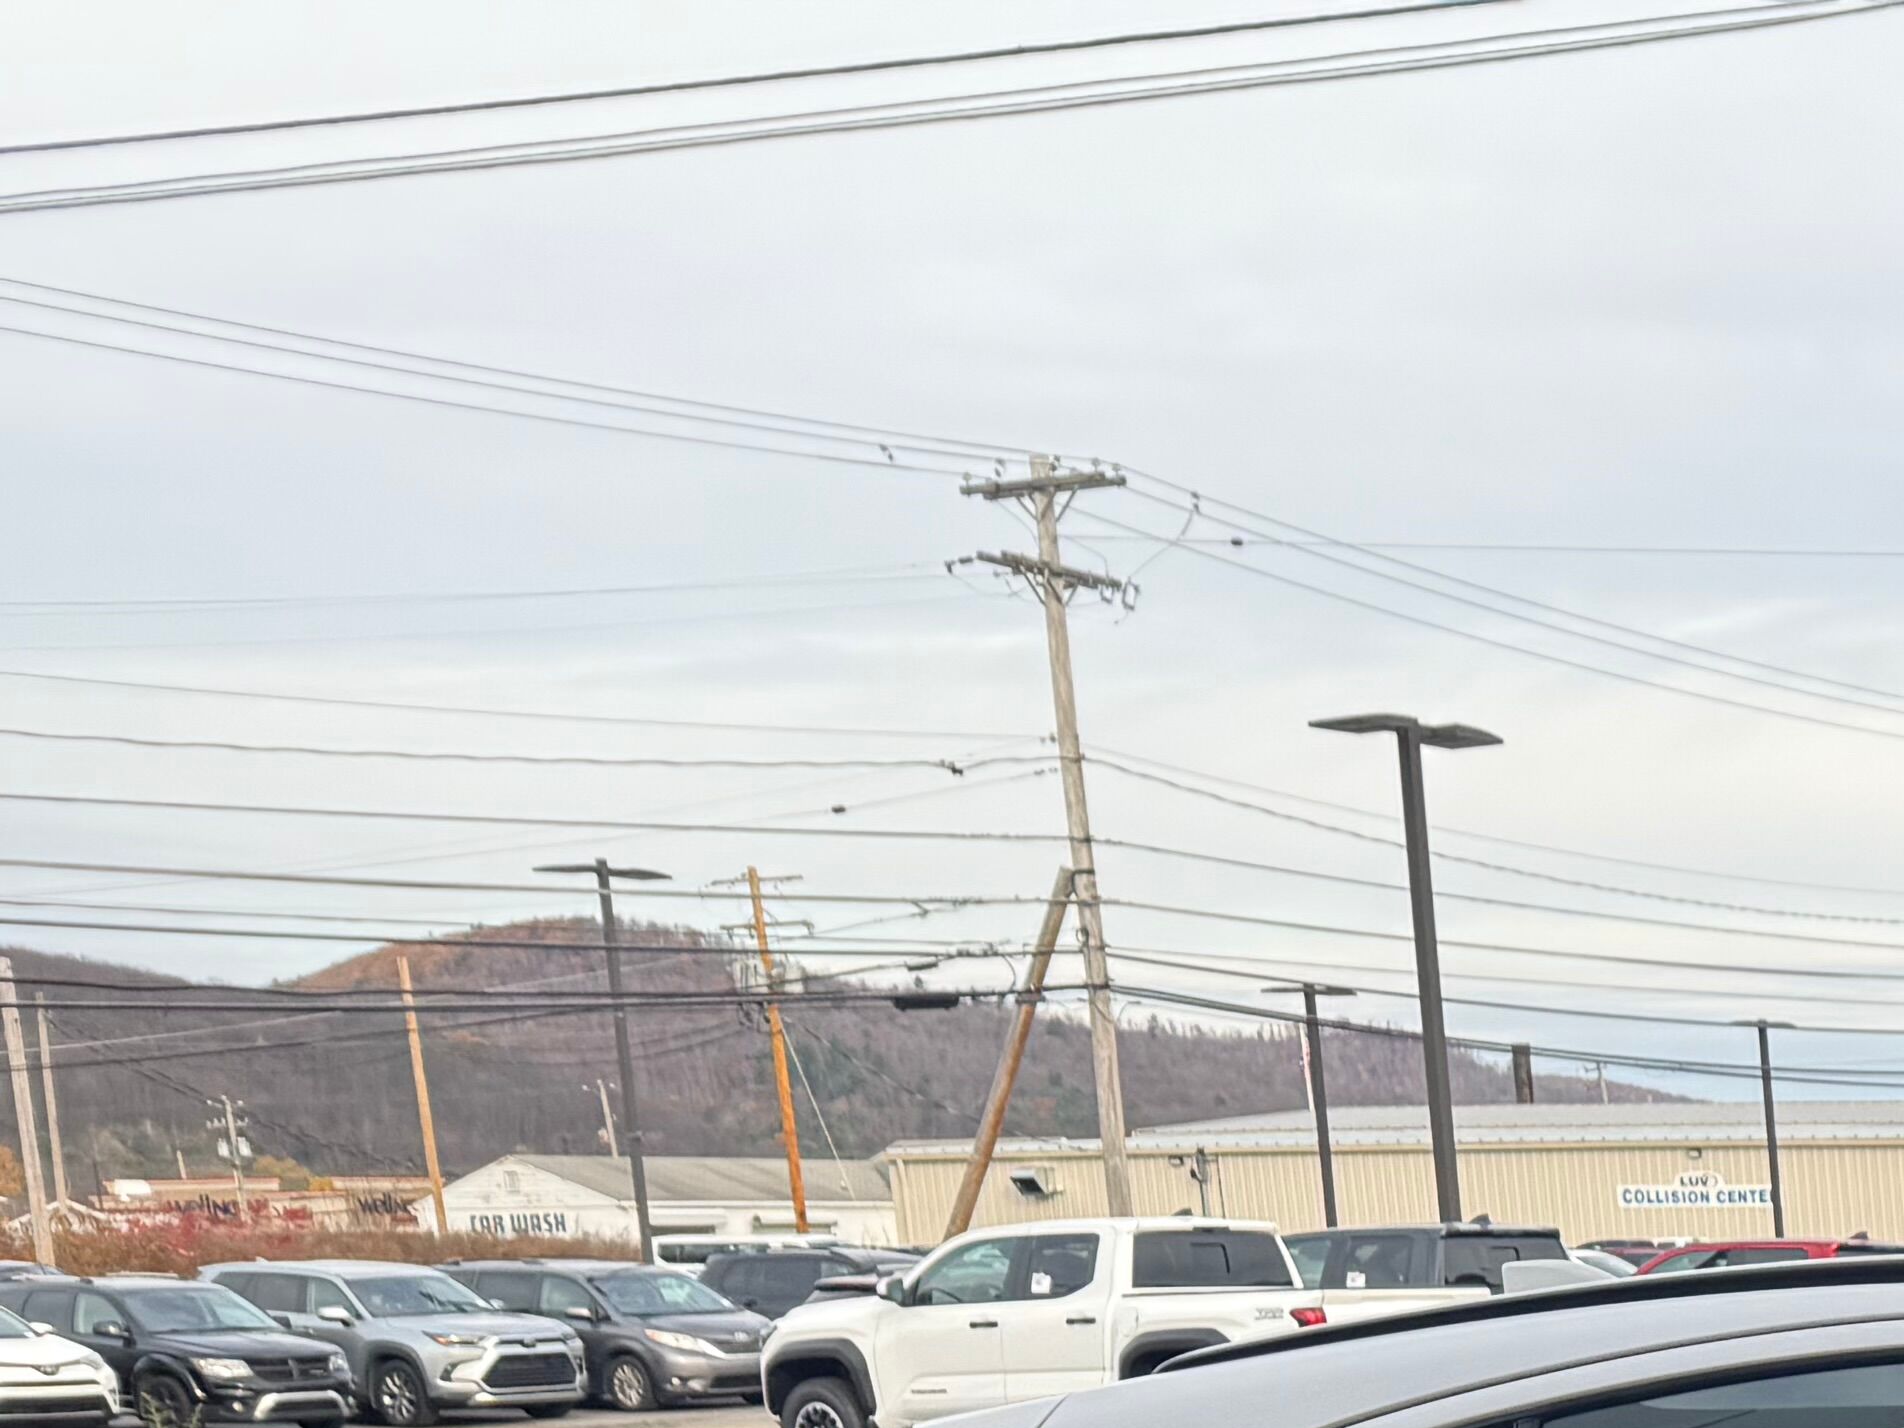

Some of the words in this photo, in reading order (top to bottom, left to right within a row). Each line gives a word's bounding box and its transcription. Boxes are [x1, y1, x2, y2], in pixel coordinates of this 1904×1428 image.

[1622, 1188, 1711, 1205] COLLISION
[1716, 1189, 1769, 1204] CENTE
[470, 1213, 505, 1234] CAR
[509, 1212, 567, 1233] WASH
